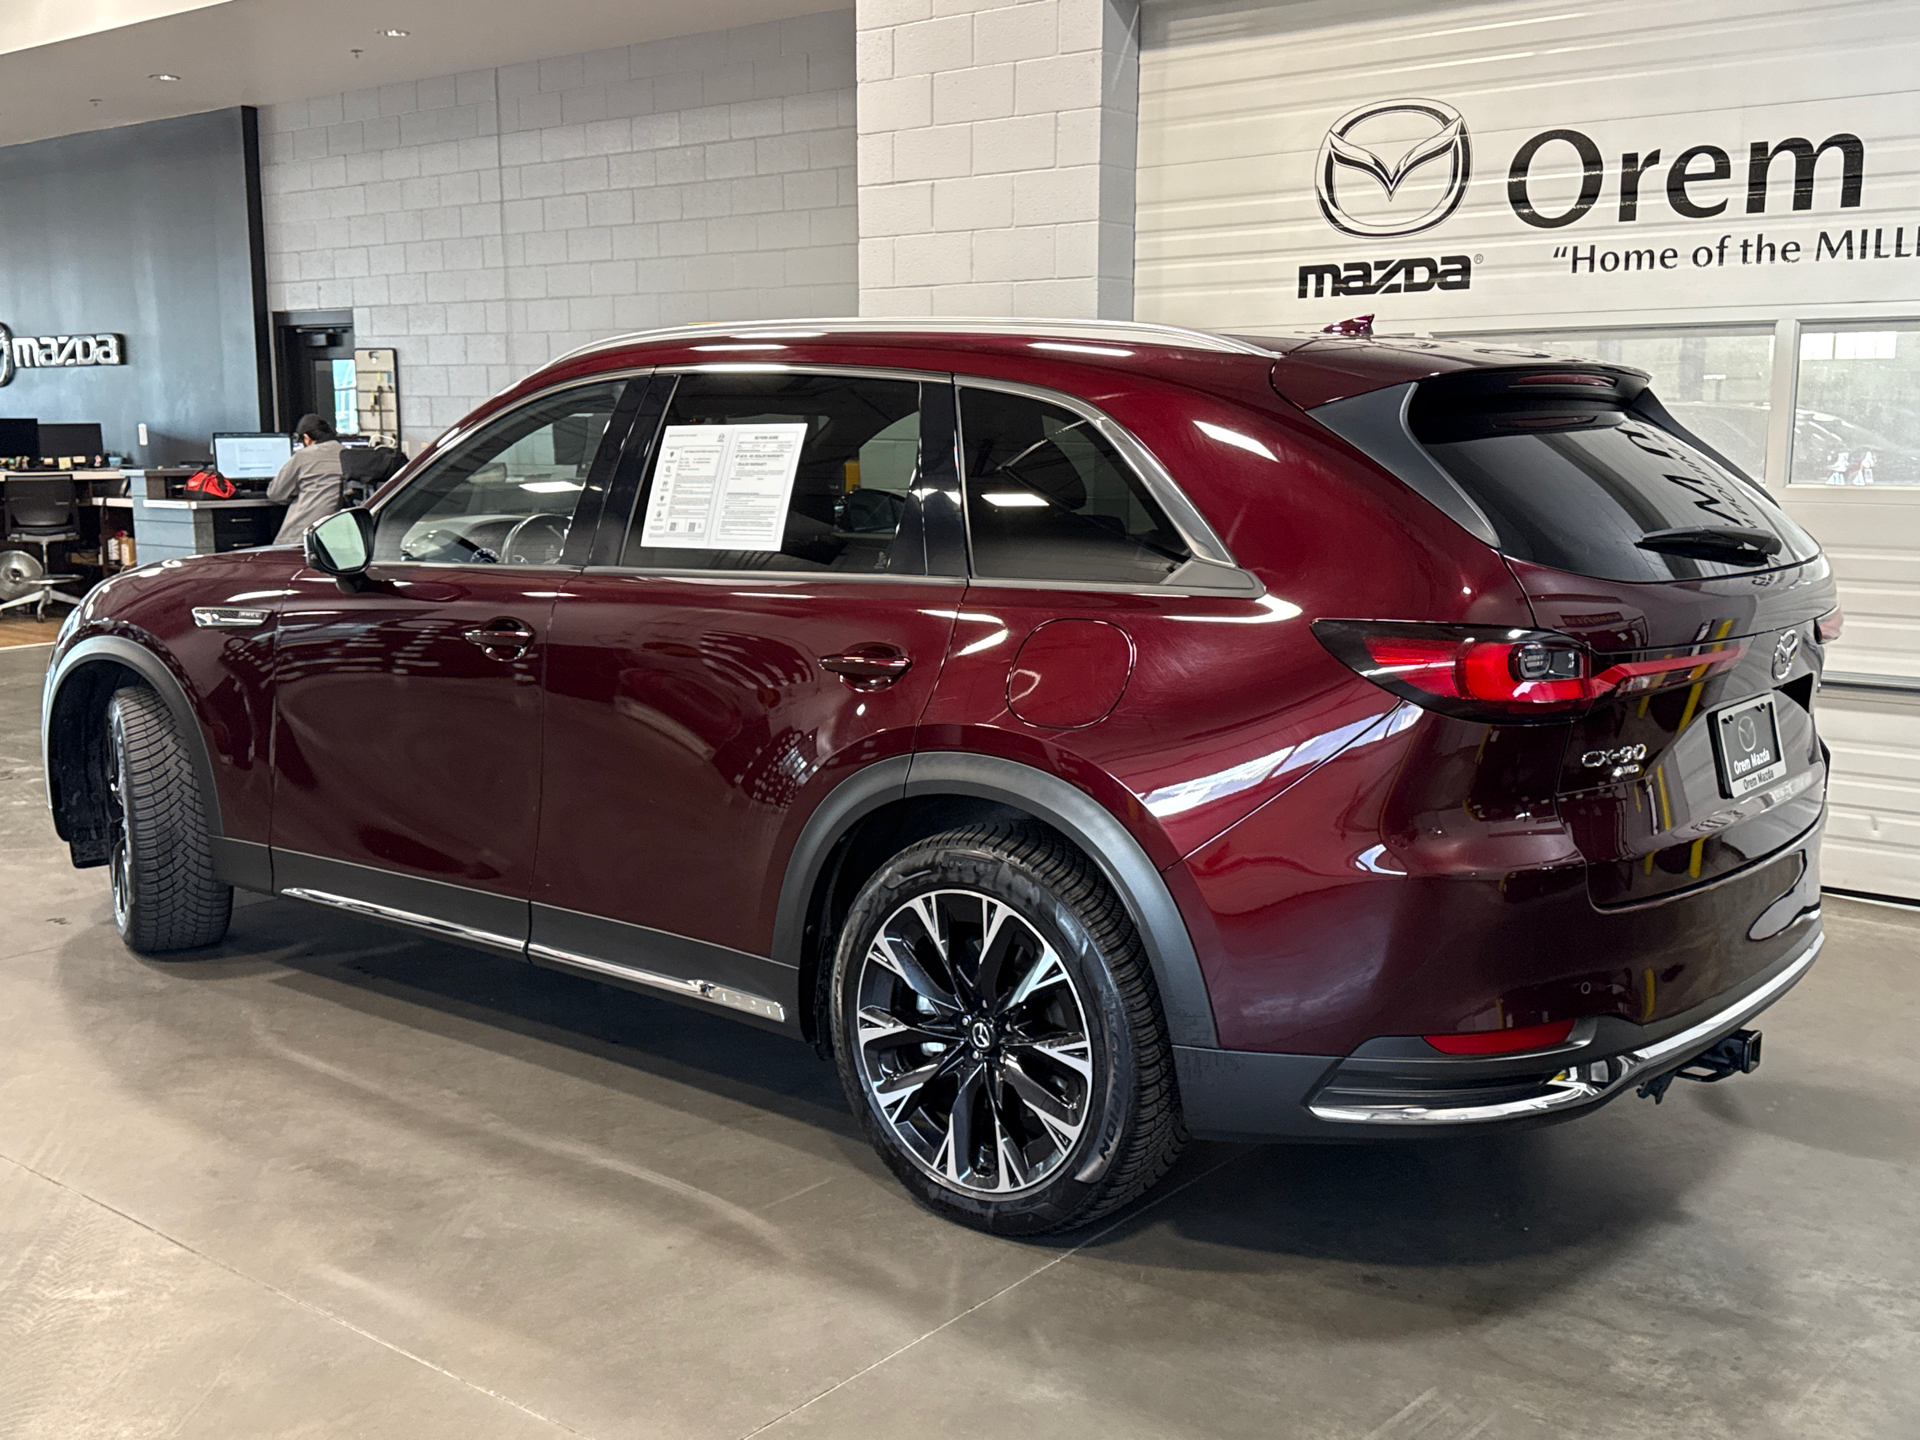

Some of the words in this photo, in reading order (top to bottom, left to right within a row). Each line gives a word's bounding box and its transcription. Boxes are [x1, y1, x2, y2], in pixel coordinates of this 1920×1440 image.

[1508, 129, 1864, 229] Orem
[1692, 235, 1732, 267] of
[1739, 233, 1801, 265] the
[11, 334, 121, 368] mazda
[1581, 743, 1647, 768] CX-90
[1733, 758, 1752, 775] Orem
[1750, 747, 1771, 768] Mazda
[1743, 777, 1758, 791] Orem
[1757, 768, 1775, 783] Mazda
